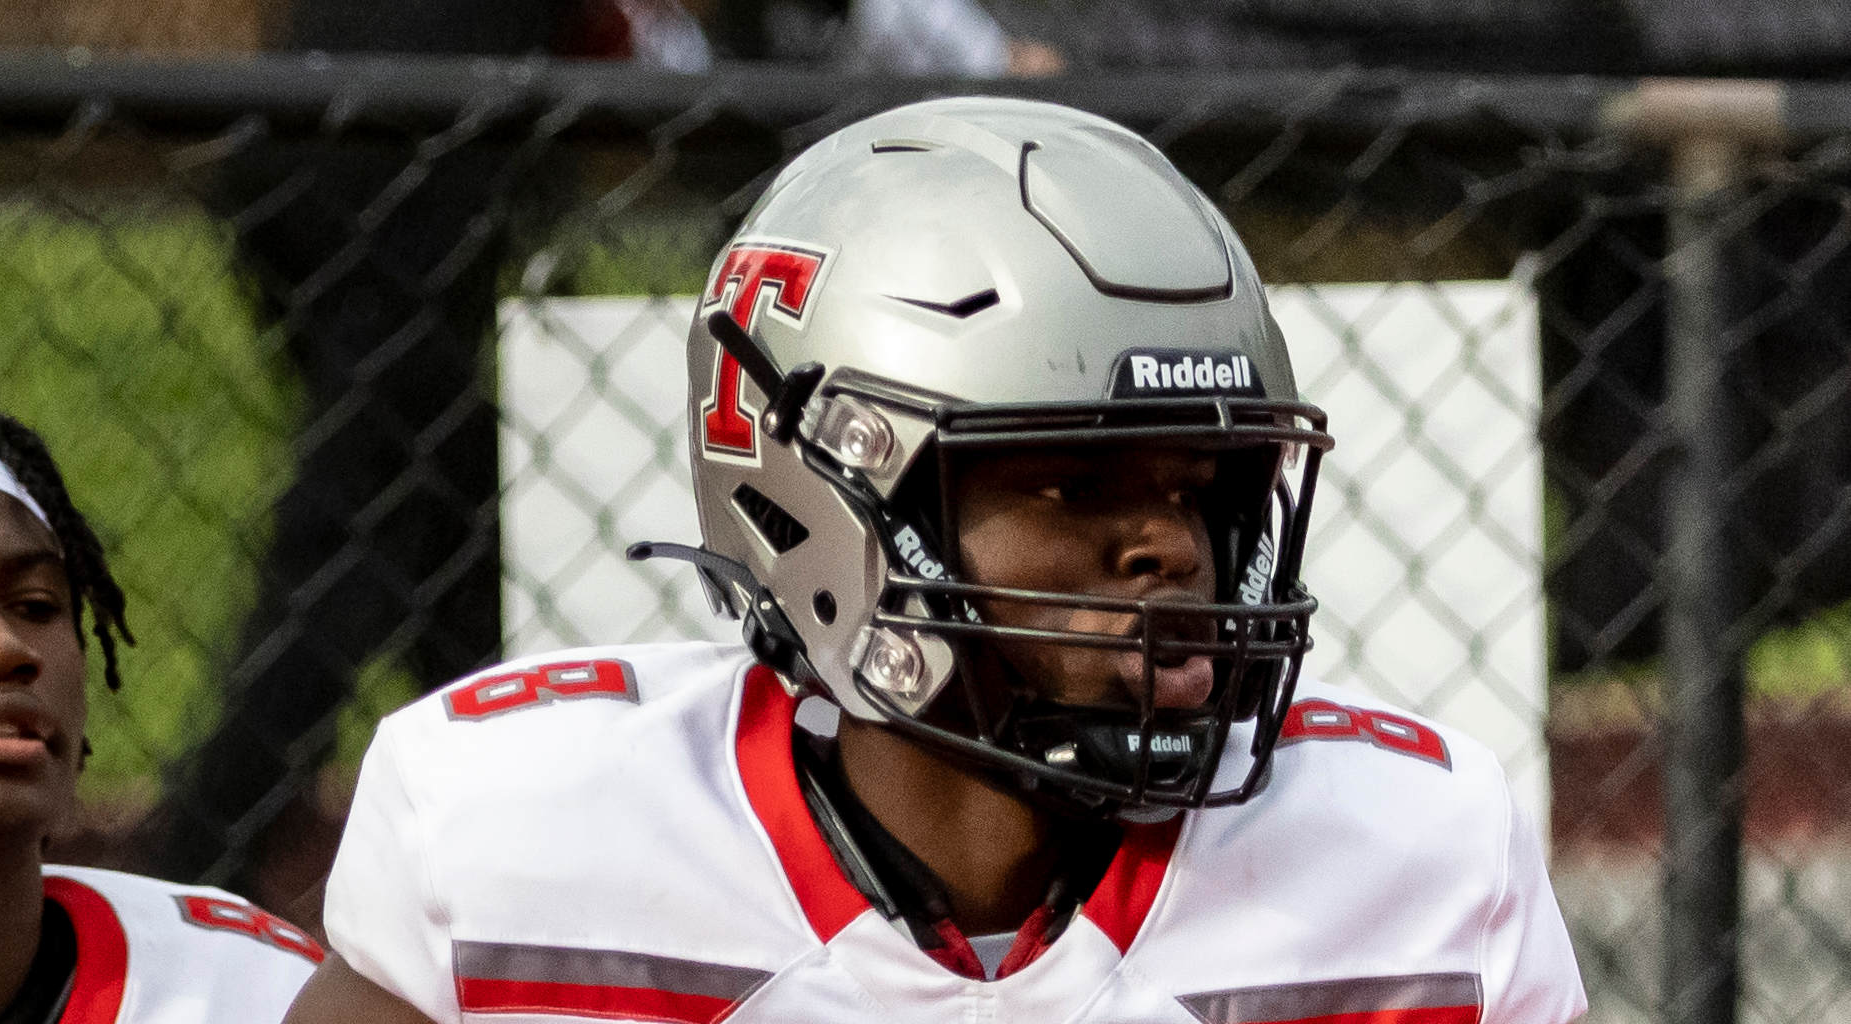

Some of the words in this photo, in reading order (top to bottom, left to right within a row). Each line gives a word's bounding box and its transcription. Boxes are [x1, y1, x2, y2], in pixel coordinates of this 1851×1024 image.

[701, 232, 831, 468] T
[1130, 355, 1252, 389] Riddell
[441, 657, 638, 723] 8
[1126, 734, 1192, 753] Rddell
[1273, 696, 1453, 774] 8
